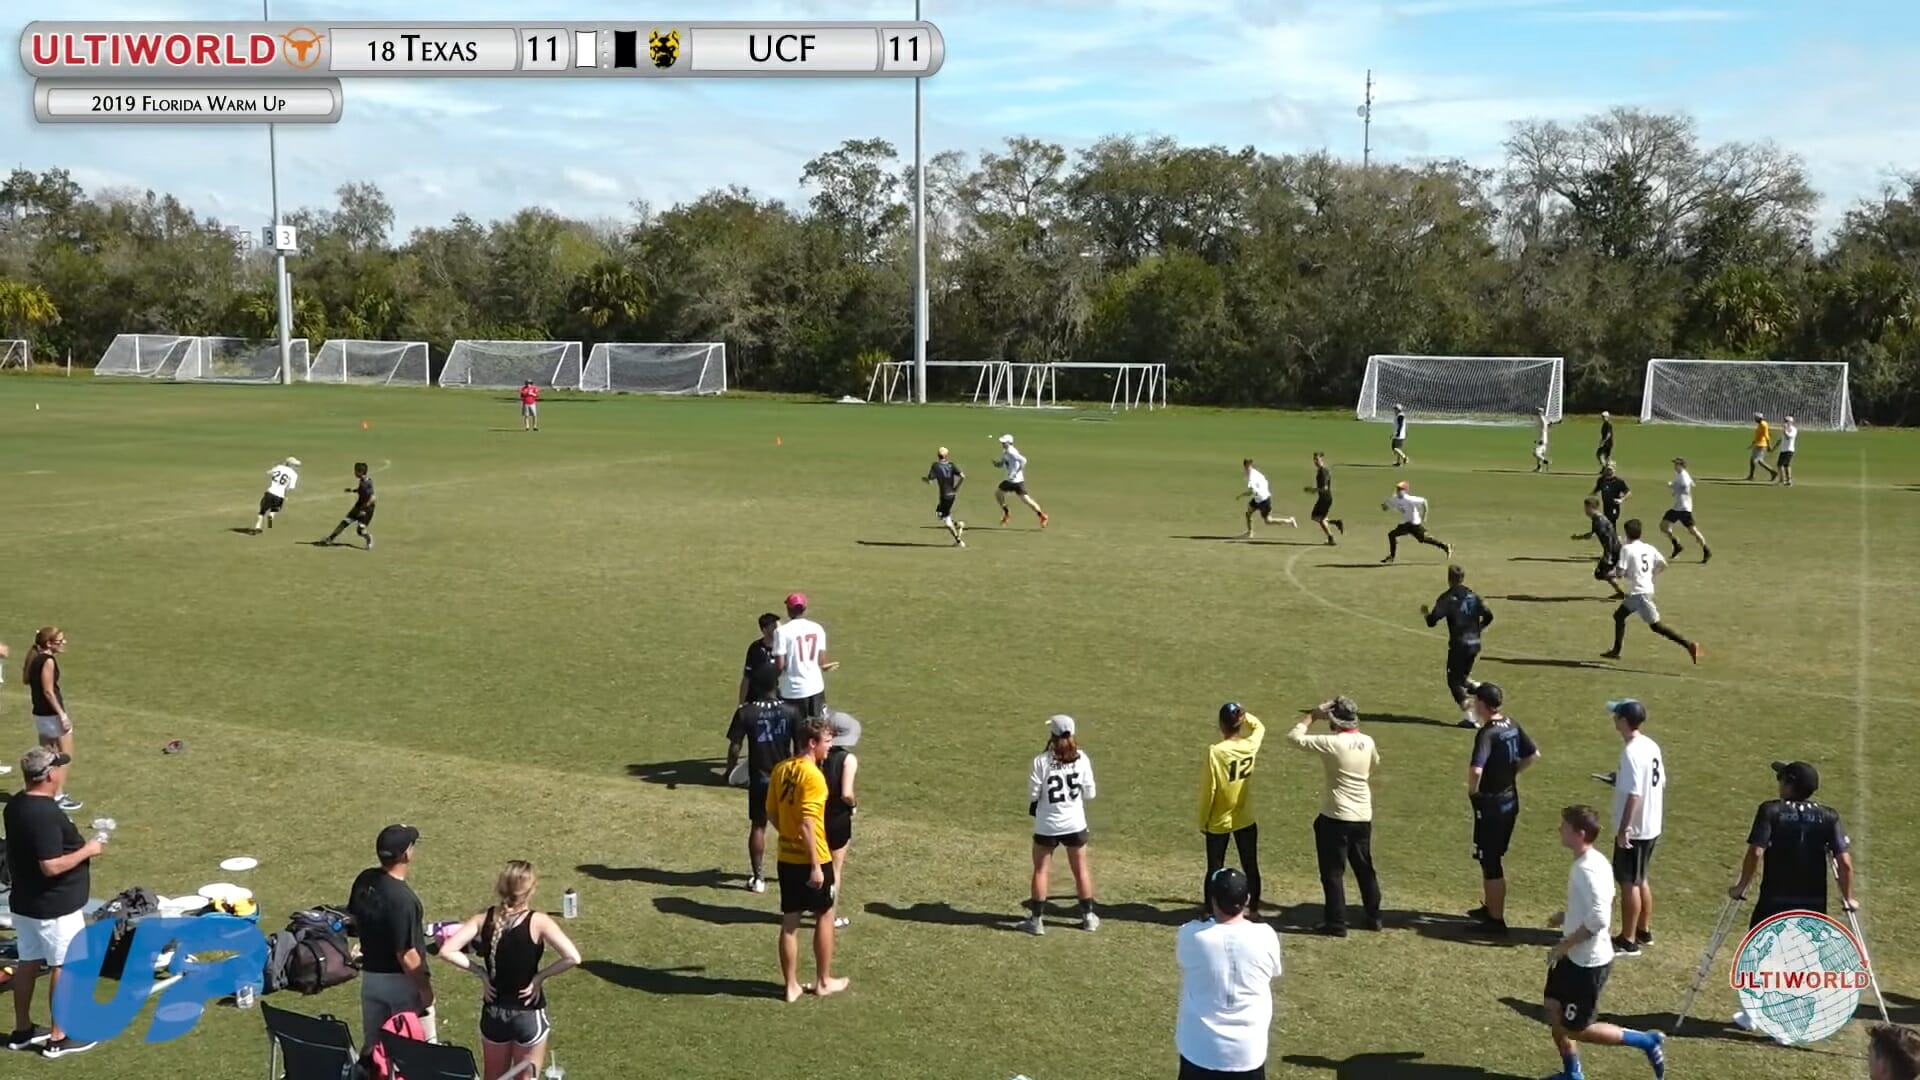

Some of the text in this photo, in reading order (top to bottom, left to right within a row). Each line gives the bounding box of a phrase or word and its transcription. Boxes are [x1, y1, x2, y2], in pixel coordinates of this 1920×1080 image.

[266, 230, 274, 246] 3
[282, 230, 290, 246] 3
[271, 470, 289, 486] 26
[1640, 553, 1650, 573] 5
[796, 633, 818, 662] 17
[1228, 756, 1254, 782] 12
[1047, 772, 1084, 804] 25
[1564, 1003, 1578, 1022] 6
